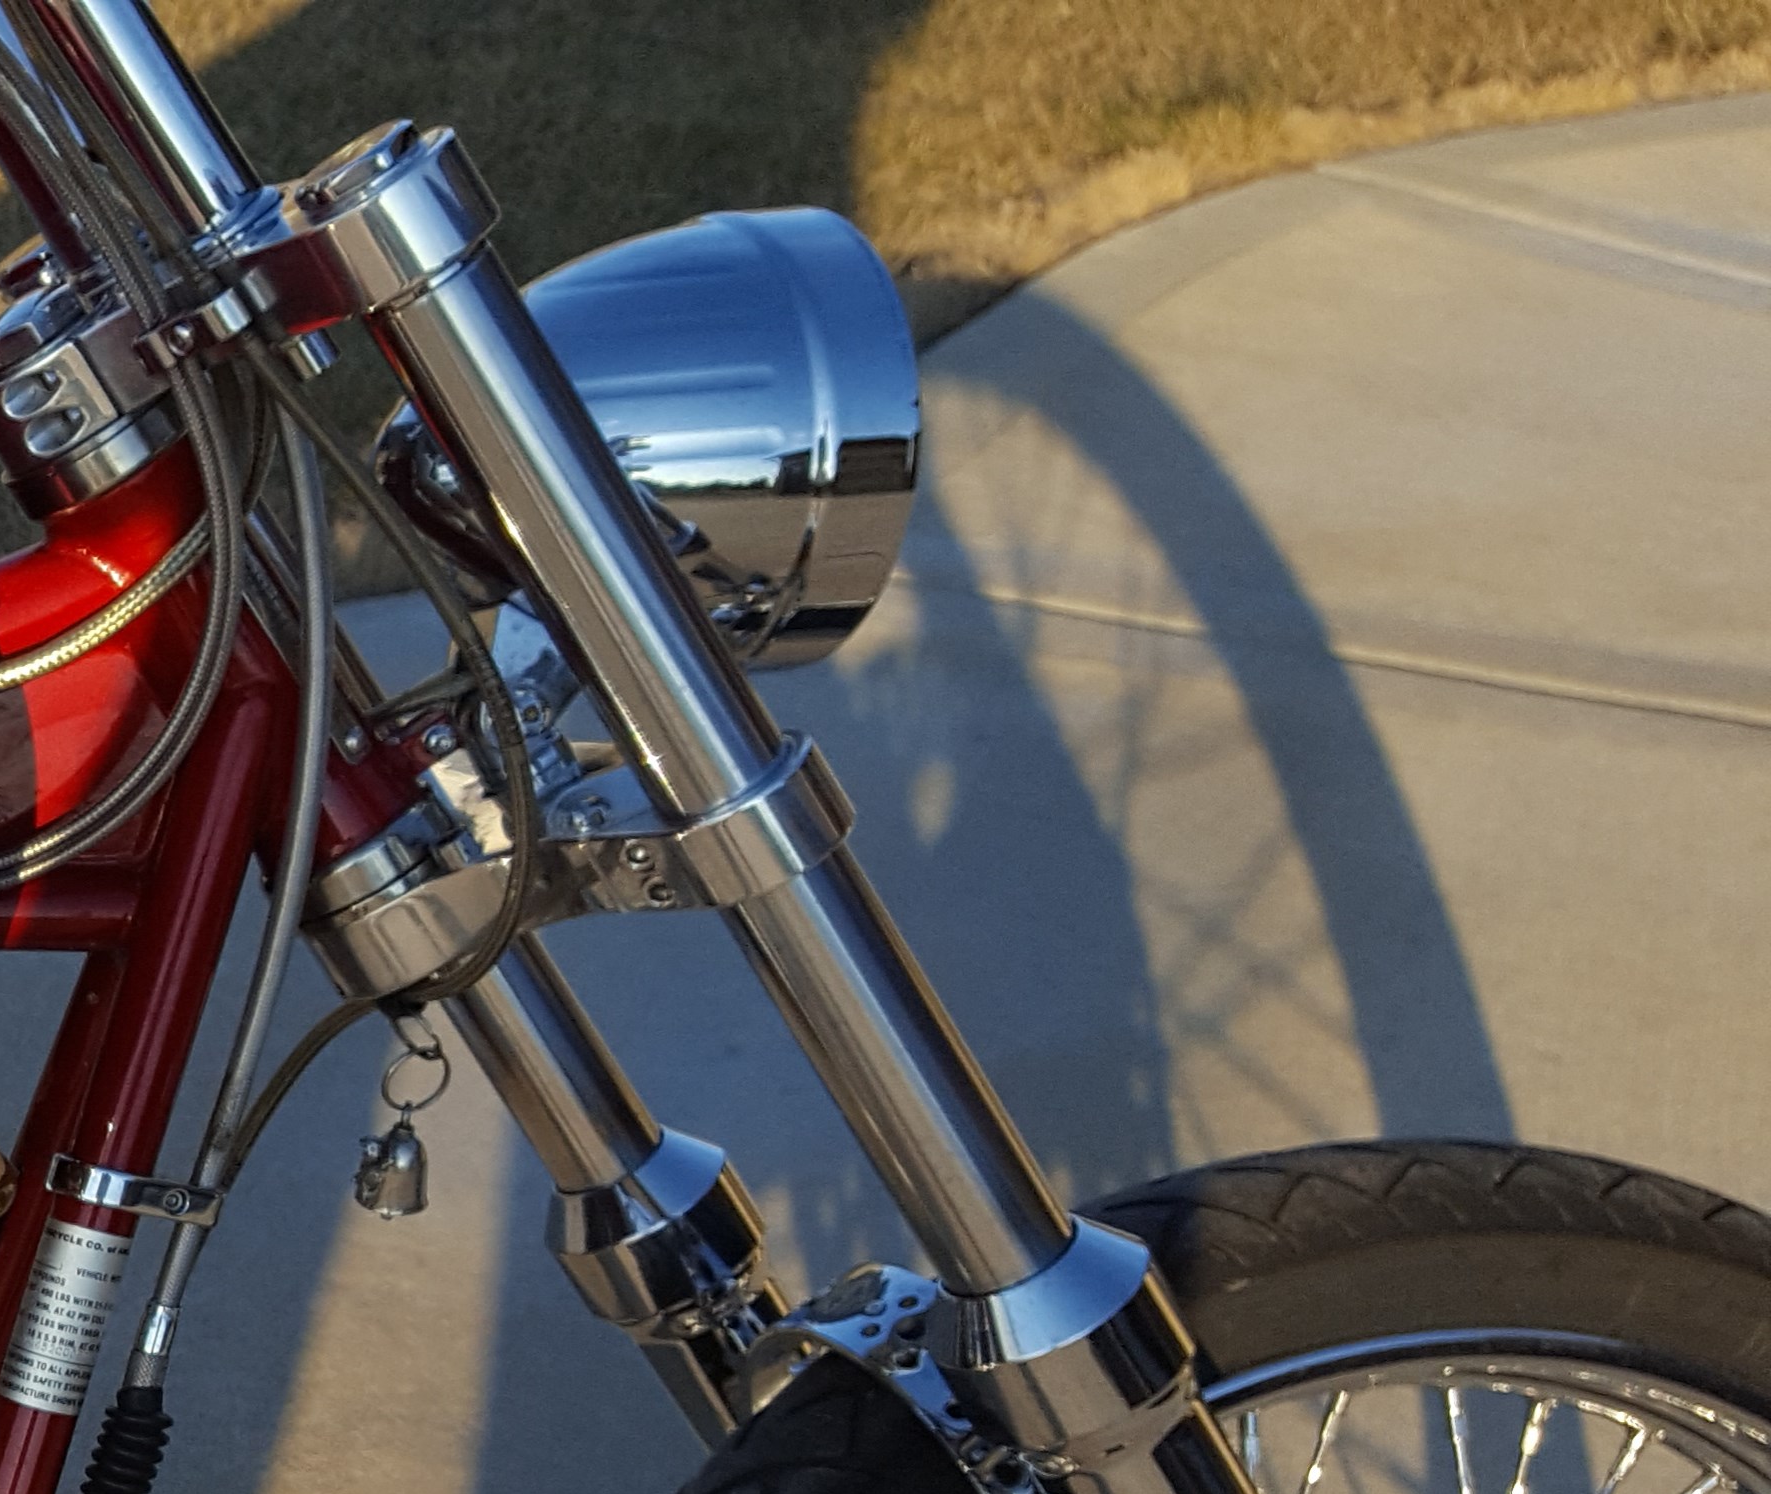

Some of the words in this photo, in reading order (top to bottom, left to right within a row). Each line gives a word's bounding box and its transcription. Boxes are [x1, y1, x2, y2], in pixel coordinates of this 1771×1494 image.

[85, 1240, 104, 1252] CO.
[57, 1322, 79, 1334] WITH
[36, 1360, 47, 1371] TO
[48, 1364, 62, 1375] ALL
[33, 1374, 63, 1389] SAFETY
